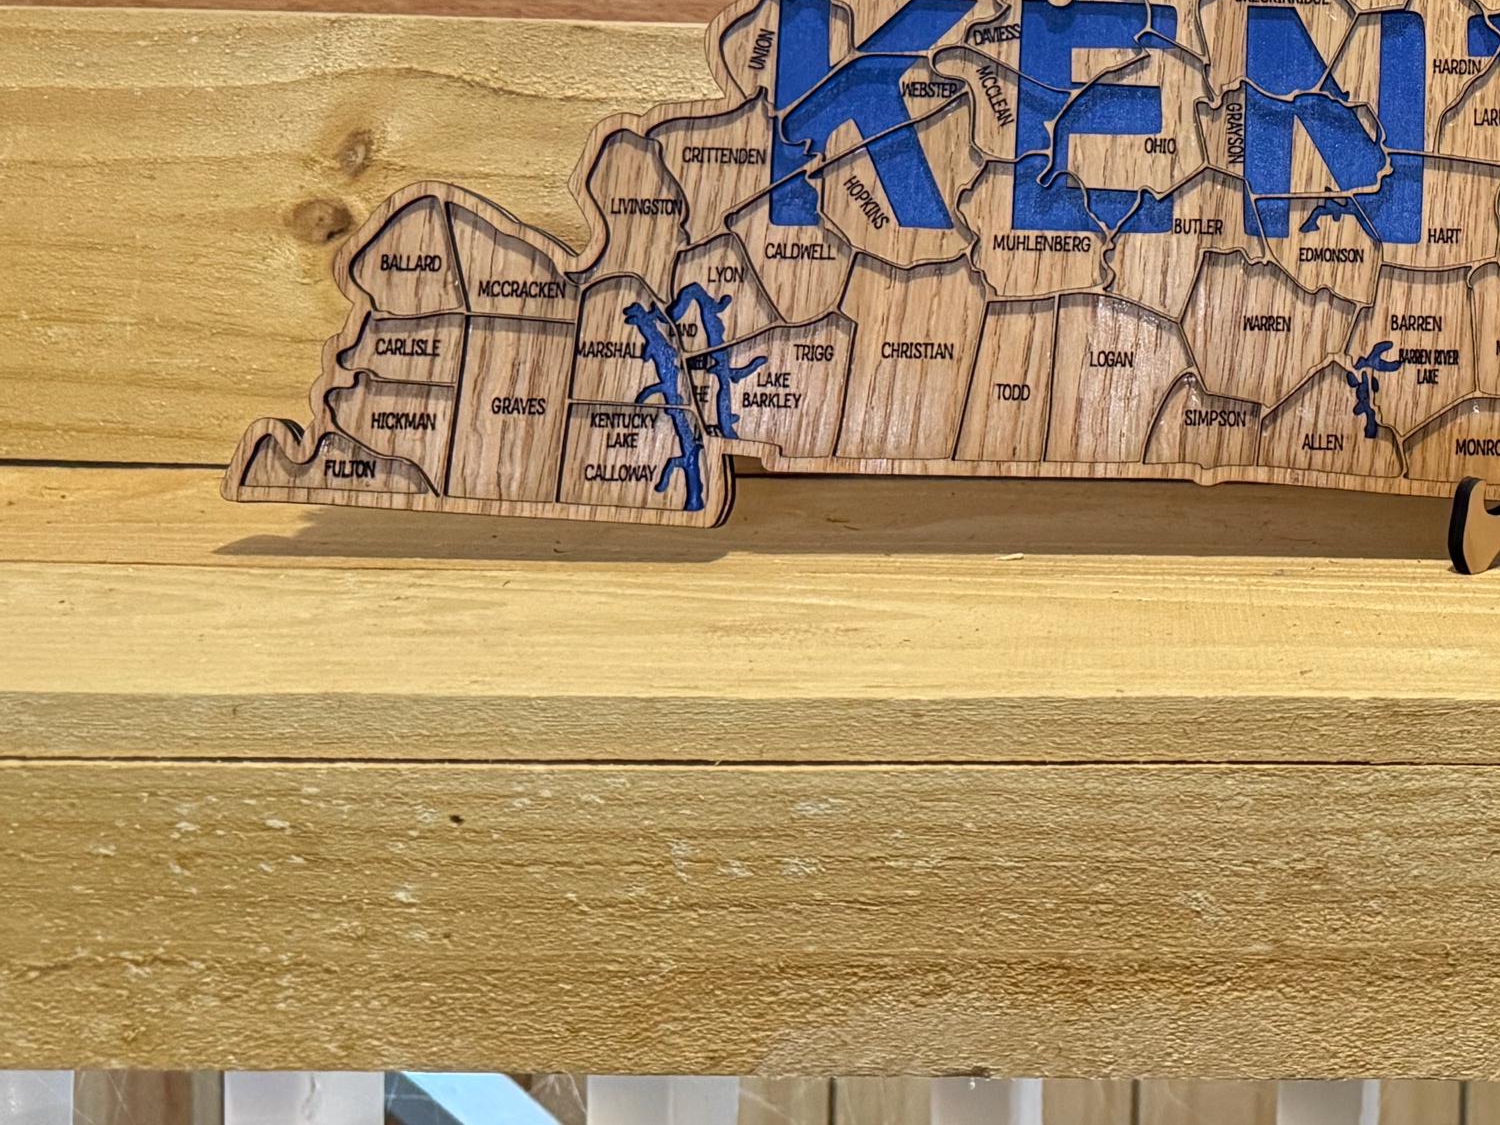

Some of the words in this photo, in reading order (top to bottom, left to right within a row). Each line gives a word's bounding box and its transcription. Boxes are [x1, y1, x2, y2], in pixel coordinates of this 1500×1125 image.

[973, 24, 1021, 45] DAVIESS
[748, 28, 776, 70] UNION
[1433, 58, 1481, 74] HARDIN
[902, 81, 957, 98] WEBSTER
[976, 65, 1013, 126] MCCLEAN
[1227, 103, 1244, 164] GRAYSON
[1145, 137, 1176, 154] OHIO
[682, 147, 767, 165] CRITTENDEN
[610, 198, 683, 215] LIVINGSTON
[843, 176, 890, 230] HOPKINS
[1174, 219, 1223, 234] BUTLER
[993, 235, 1091, 252] MUHLENBERG
[1428, 228, 1461, 244] HART
[765, 242, 836, 260] CALDWELL
[1300, 248, 1364, 263] EDMONSON
[380, 254, 442, 273] BALLARD
[708, 267, 744, 283] LYON
[478, 280, 566, 299] MCCRACKEN
[1243, 316, 1291, 332] WARREN
[1391, 315, 1442, 331] BARREN
[375, 338, 441, 357] CARLISLE
[794, 344, 834, 361] TRIGG
[881, 342, 954, 360] CHRISTIAN
[1090, 351, 1133, 367] LOGAN
[1399, 348, 1431, 364] BARREN
[1434, 349, 1459, 365] RIVER
[757, 373, 790, 388] LAKE
[1417, 368, 1439, 385] LAKE
[742, 392, 801, 408] BARKLEY
[996, 383, 1030, 400] TODD
[491, 398, 546, 415] GRAVES
[371, 413, 437, 431] HICKMAN
[590, 413, 658, 429] KENTUCKY
[1184, 410, 1246, 427] SIMPSON
[606, 433, 638, 448] LAKE
[1302, 434, 1344, 451] ALLEN
[324, 460, 376, 478] FULTON
[584, 464, 657, 482] CALLOWAY
